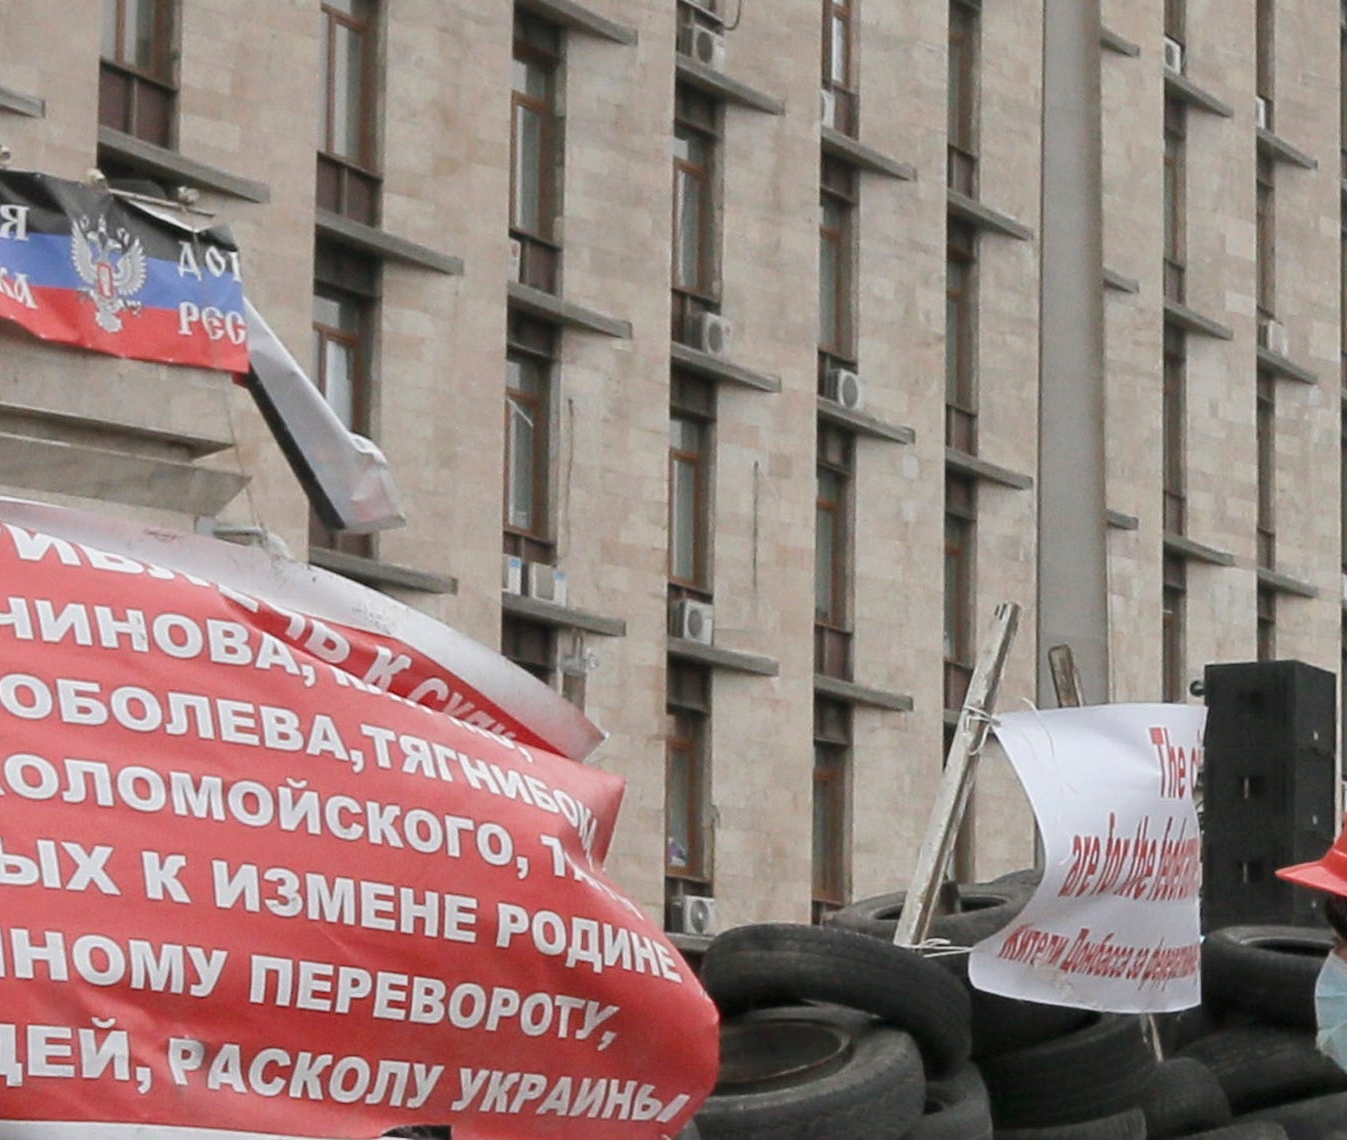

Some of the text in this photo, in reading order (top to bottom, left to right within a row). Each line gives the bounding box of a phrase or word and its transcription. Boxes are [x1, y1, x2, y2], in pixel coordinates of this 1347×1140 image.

[141, 851, 192, 904] К
[213, 858, 476, 943] ИЗМЕНЕ
[495, 902, 683, 985] РОДИНЕ
[249, 953, 620, 1051] ПЕРЕВОРОТУ,
[167, 1036, 445, 1112] РАСКОЛУ
[450, 1066, 691, 1124] УКРАИНЫ
